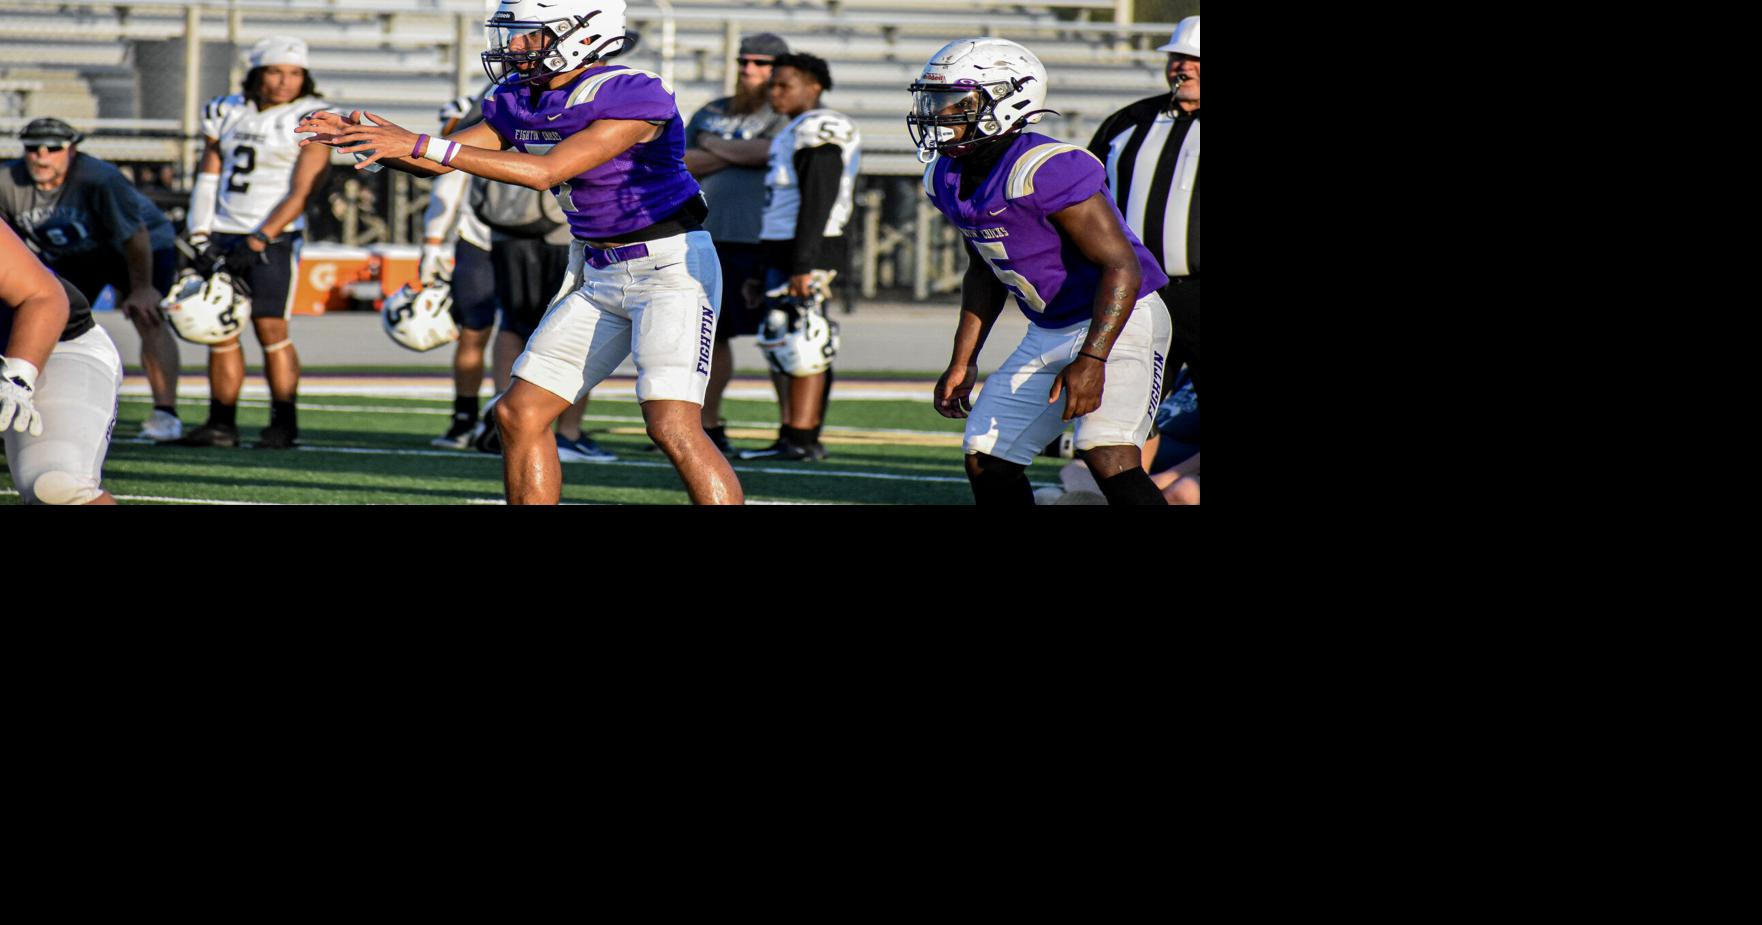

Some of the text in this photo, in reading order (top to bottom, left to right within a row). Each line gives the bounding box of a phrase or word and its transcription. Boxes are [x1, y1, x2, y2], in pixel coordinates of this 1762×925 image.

[226, 145, 255, 193] 2
[309, 262, 338, 292] G
[972, 240, 1047, 314] 5
[696, 305, 714, 377] FIGHTIN
[1147, 350, 1165, 421] FIGHTIN
